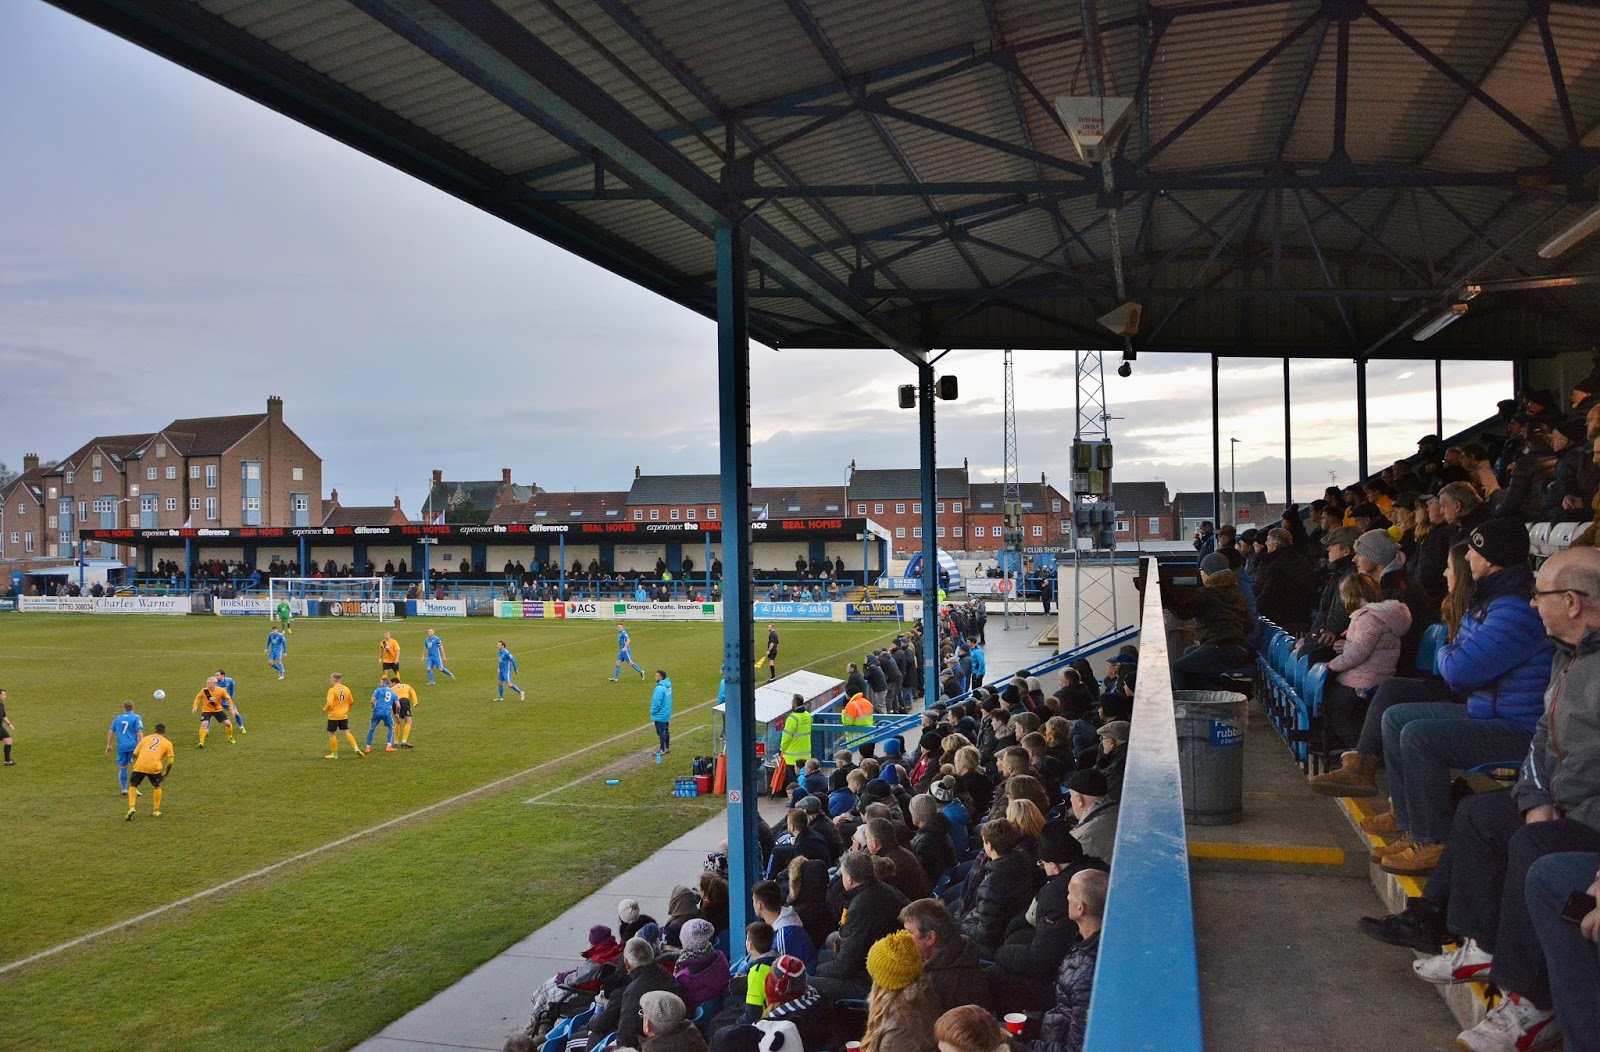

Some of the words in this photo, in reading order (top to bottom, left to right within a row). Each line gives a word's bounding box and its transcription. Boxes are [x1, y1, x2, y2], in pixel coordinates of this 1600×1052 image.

[529, 524, 568, 532] difference
[606, 522, 636, 532] HOMES
[684, 522, 698, 530] the
[808, 520, 842, 528] HOMES
[258, 528, 284, 536] HOMES
[423, 526, 450, 534] HOMES
[96, 598, 134, 608] Charles
[138, 598, 176, 608] Warner
[342, 602, 395, 614] vanarama
[578, 604, 596, 612] ACS
[338, 688, 346, 702] 6
[384, 692, 392, 702] 9
[122, 720, 128, 734] 7
[148, 736, 160, 751] 2
